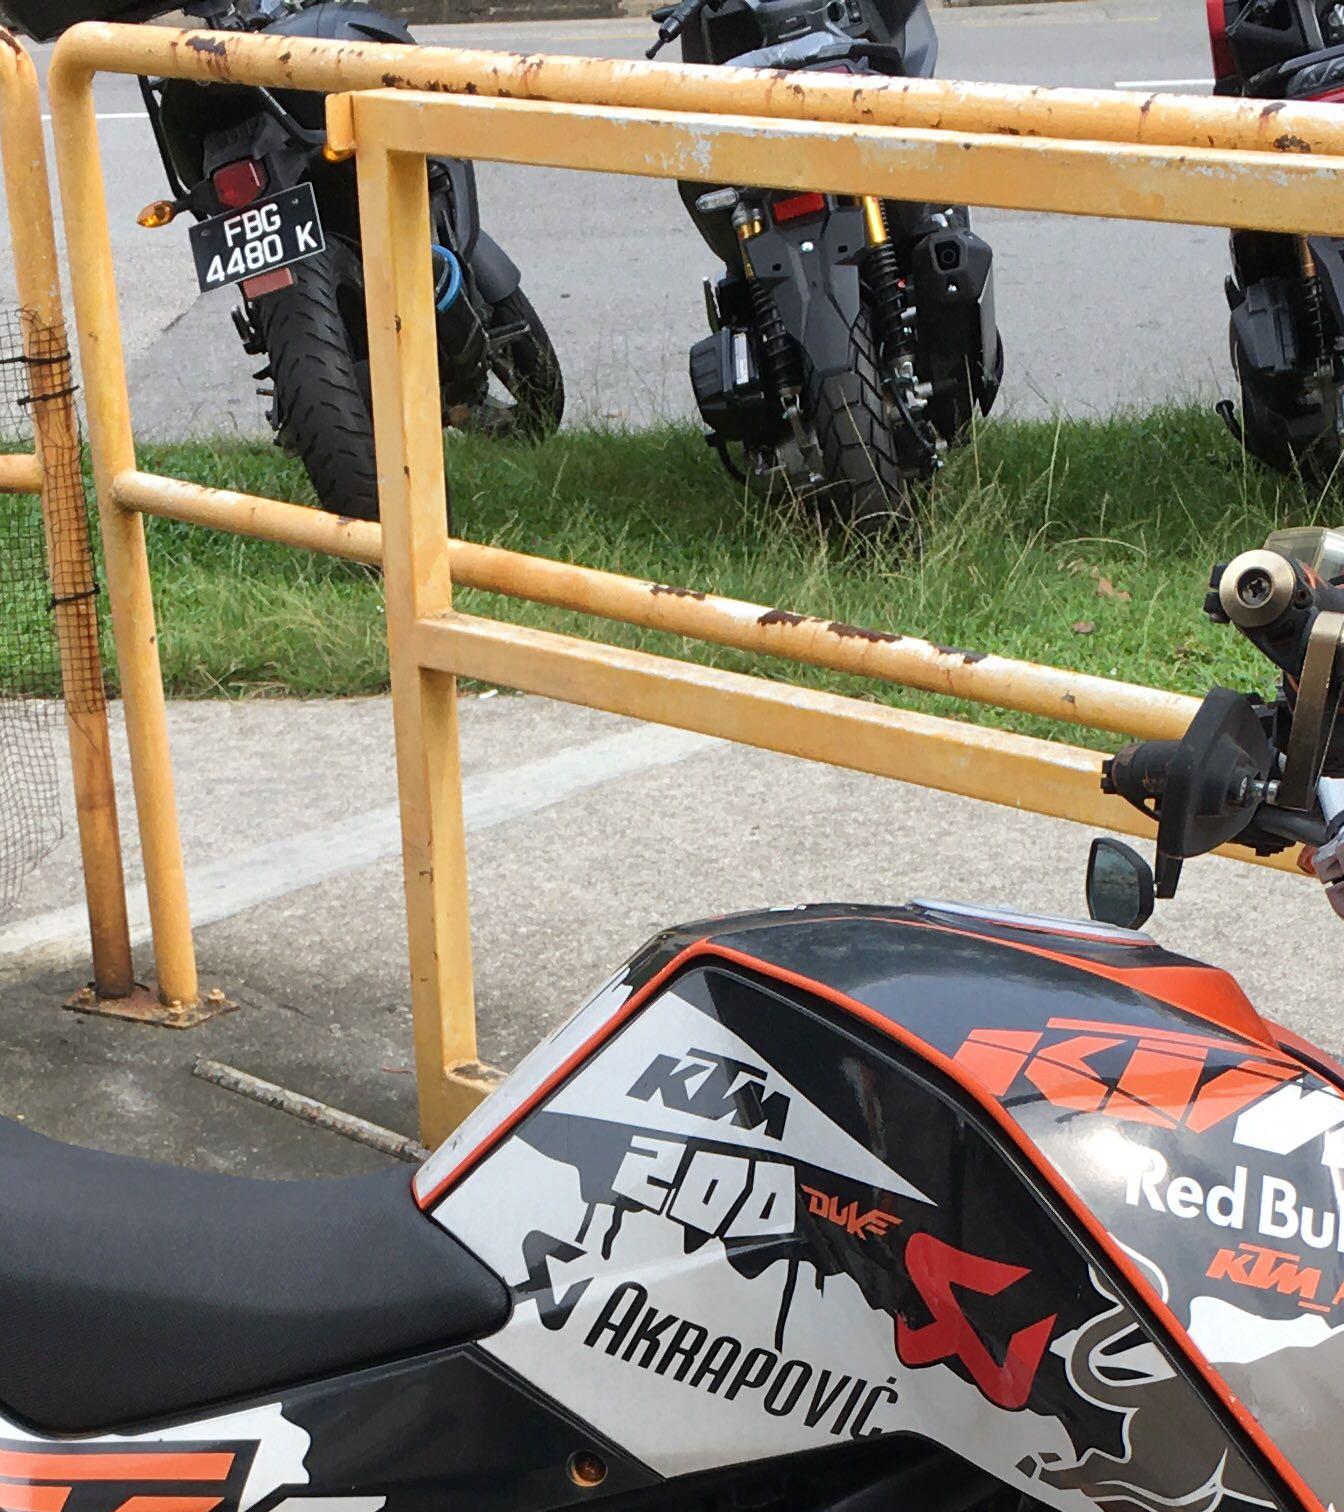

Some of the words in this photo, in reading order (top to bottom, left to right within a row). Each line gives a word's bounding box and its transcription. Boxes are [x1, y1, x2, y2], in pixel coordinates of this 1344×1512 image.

[206, 233, 284, 283] 4480
[295, 220, 318, 252] K
[223, 203, 281, 247] FBG
[626, 1048, 791, 1140] KTM
[612, 1135, 797, 1237] 200
[800, 1183, 904, 1239] DUKE
[1124, 1152, 1247, 1229] Red
[1206, 1243, 1330, 1312] KTM
